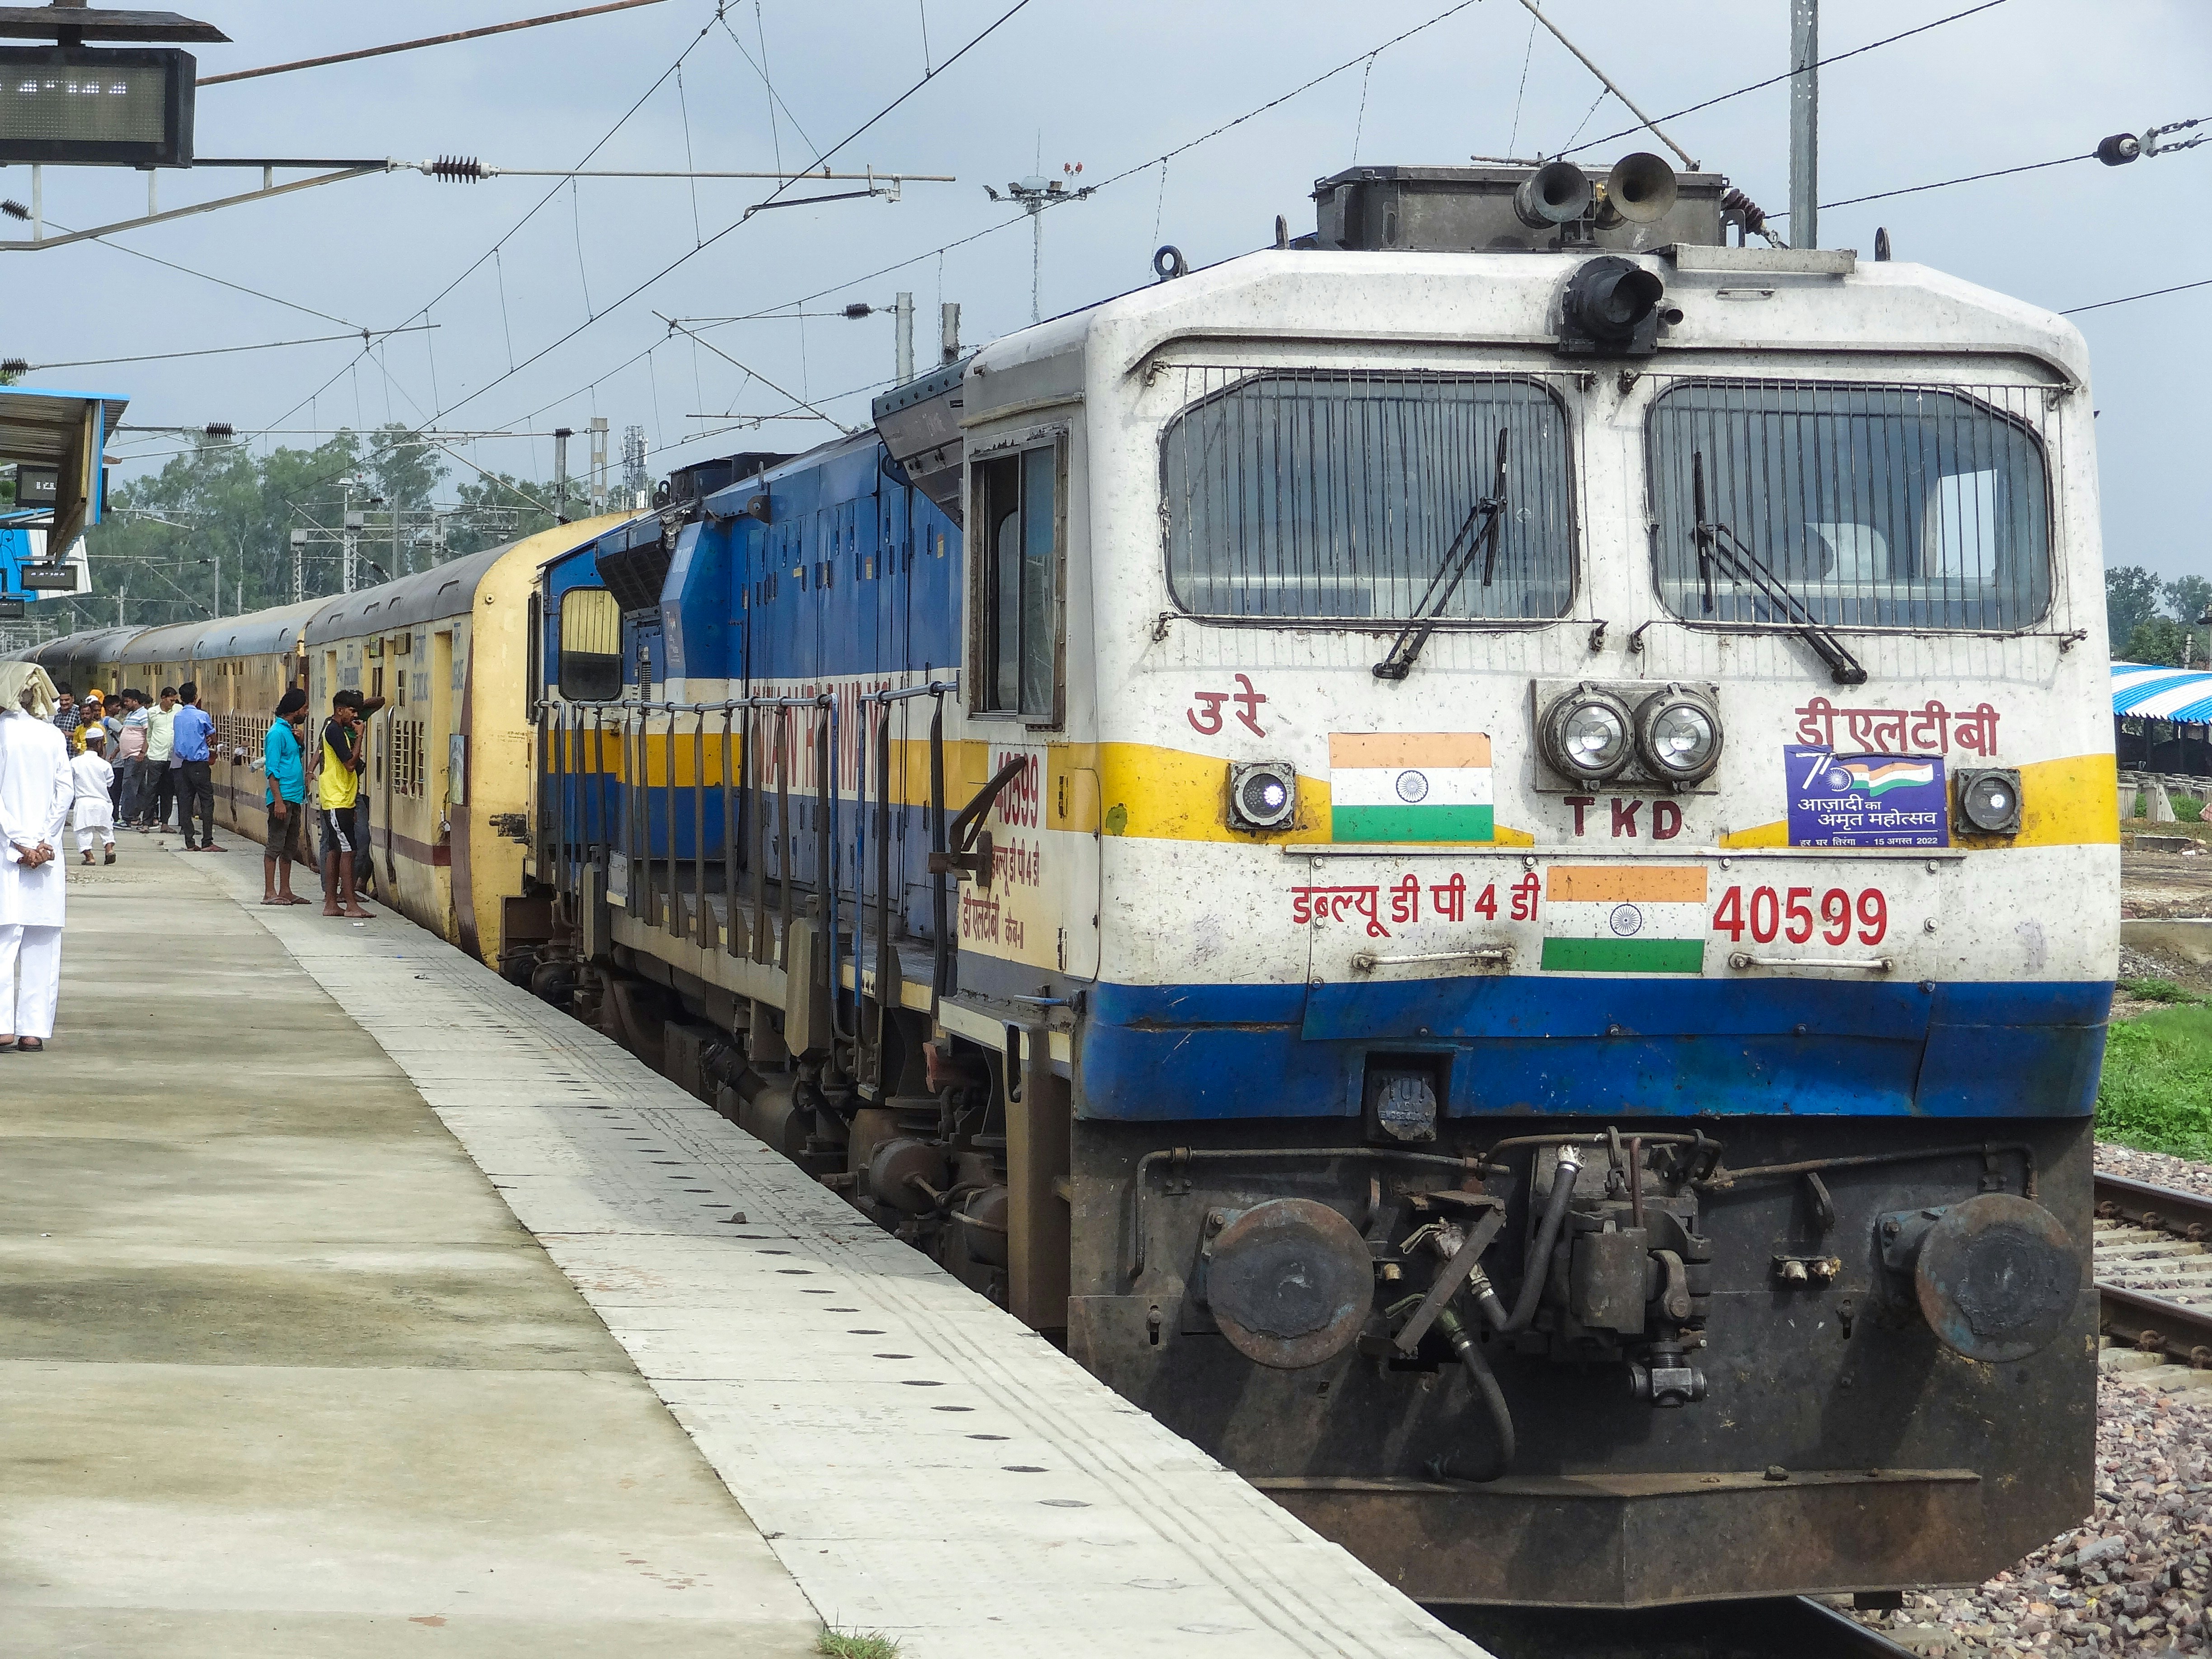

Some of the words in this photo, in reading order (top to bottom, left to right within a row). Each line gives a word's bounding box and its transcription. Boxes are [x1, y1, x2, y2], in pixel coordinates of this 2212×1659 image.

[1865, 801, 1882, 810] का
[1818, 813, 1863, 830] अमृत
[1868, 808, 1938, 827] महोत्सव
[1832, 836, 1856, 846] तिरंगा
[1712, 886, 1887, 946] 40599
